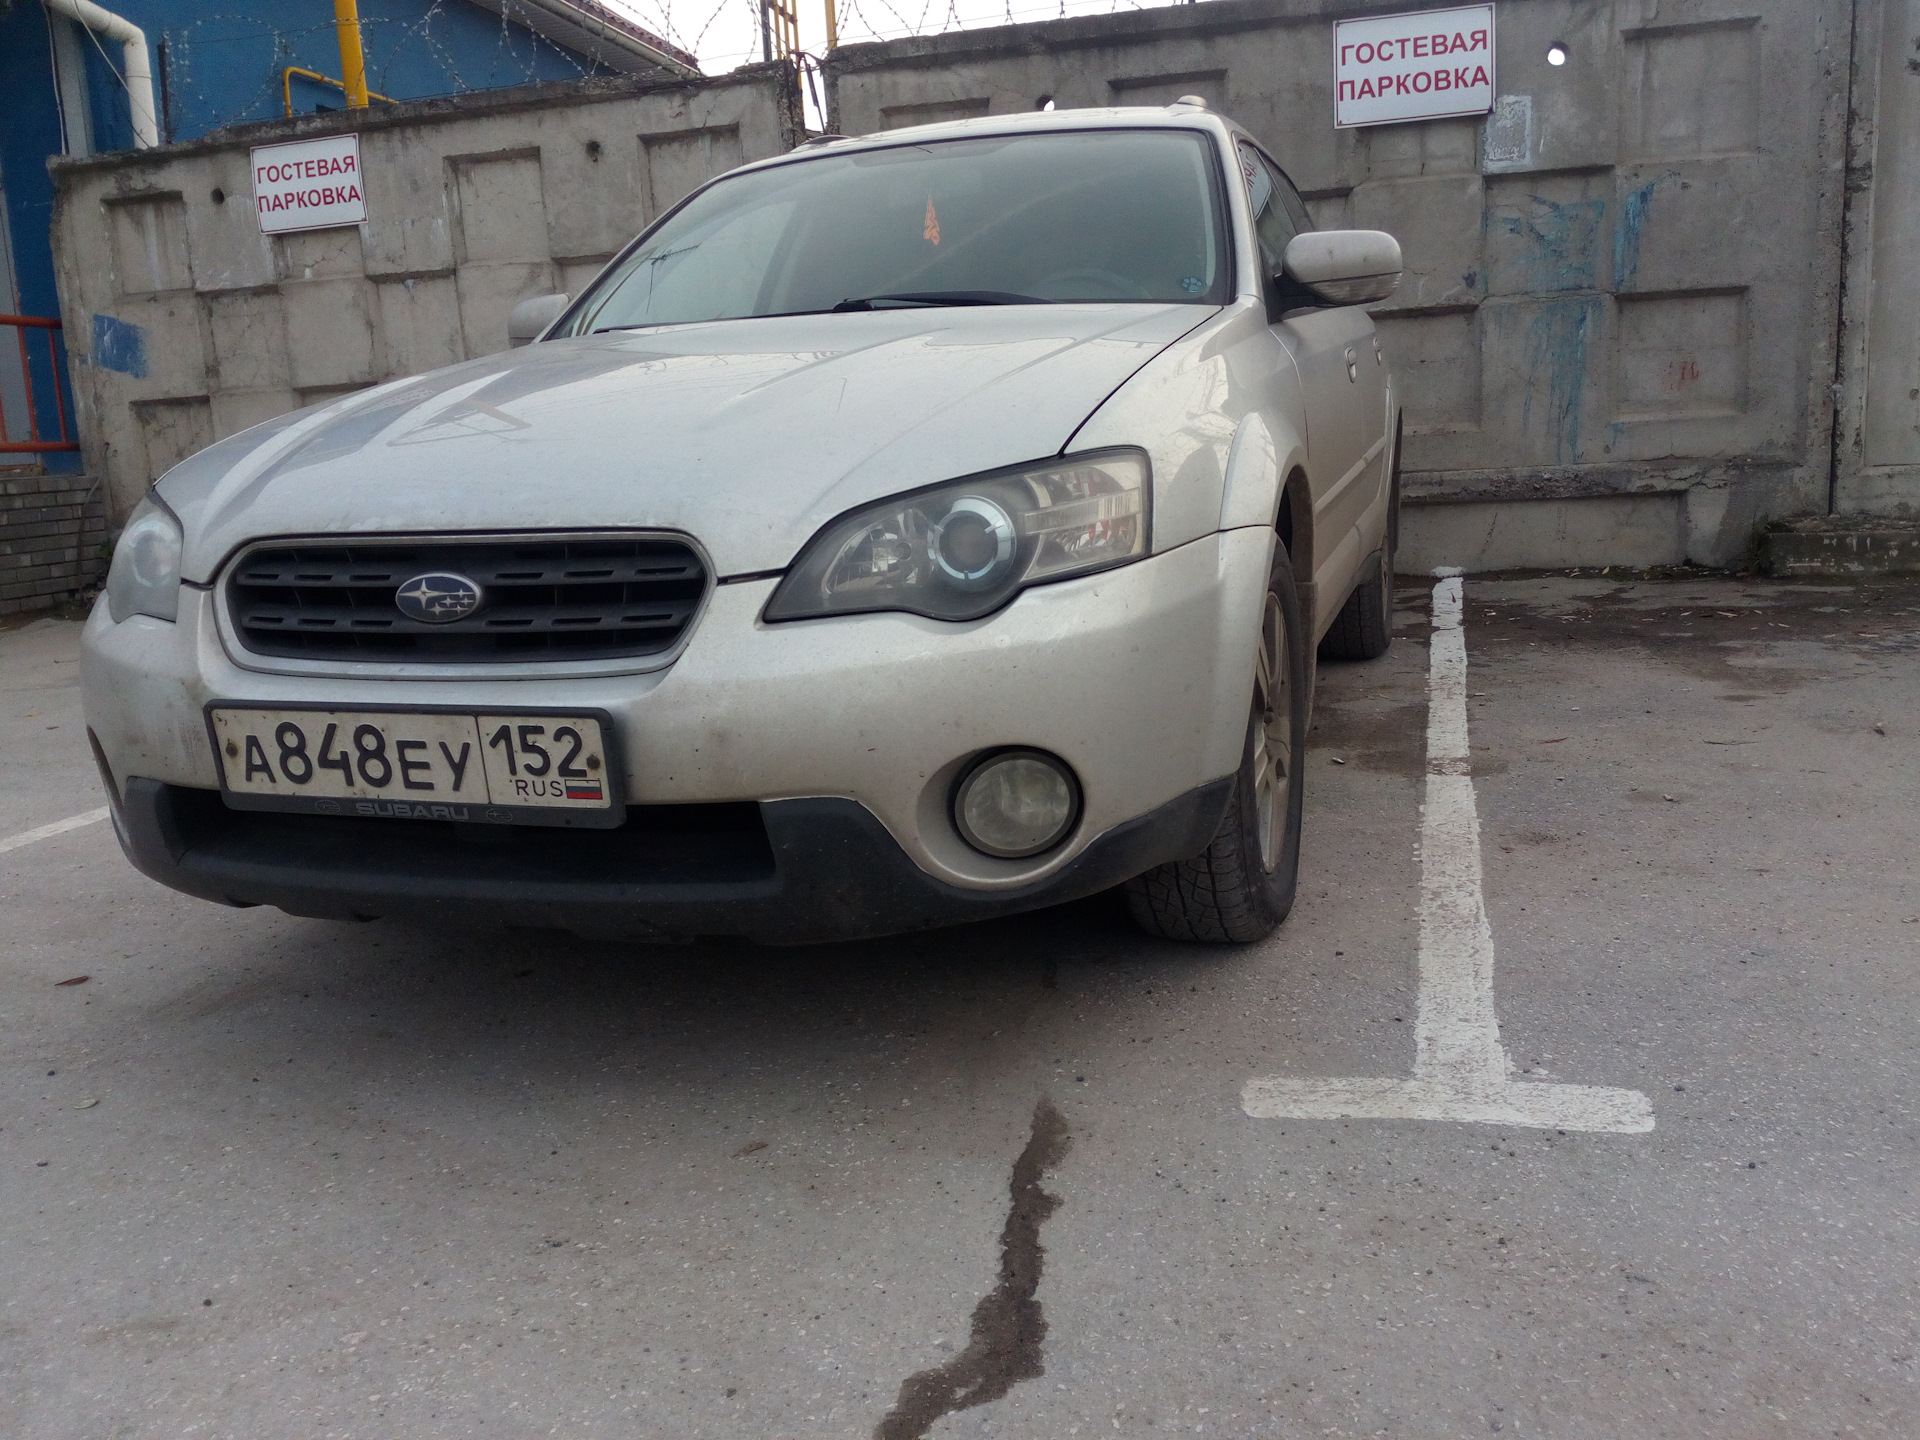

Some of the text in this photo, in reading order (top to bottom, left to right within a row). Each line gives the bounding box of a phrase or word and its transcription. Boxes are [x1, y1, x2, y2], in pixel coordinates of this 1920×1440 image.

[1340, 29, 1488, 67] ГОСТЕВАЯ
[1338, 65, 1490, 102] ПАРКОВКА
[256, 154, 356, 185] ГОСТЕВАЯ
[257, 184, 362, 213] ПАРКОВКА
[488, 724, 588, 778] 152
[515, 778, 564, 797] RUS
[355, 802, 470, 821] SUBARU
